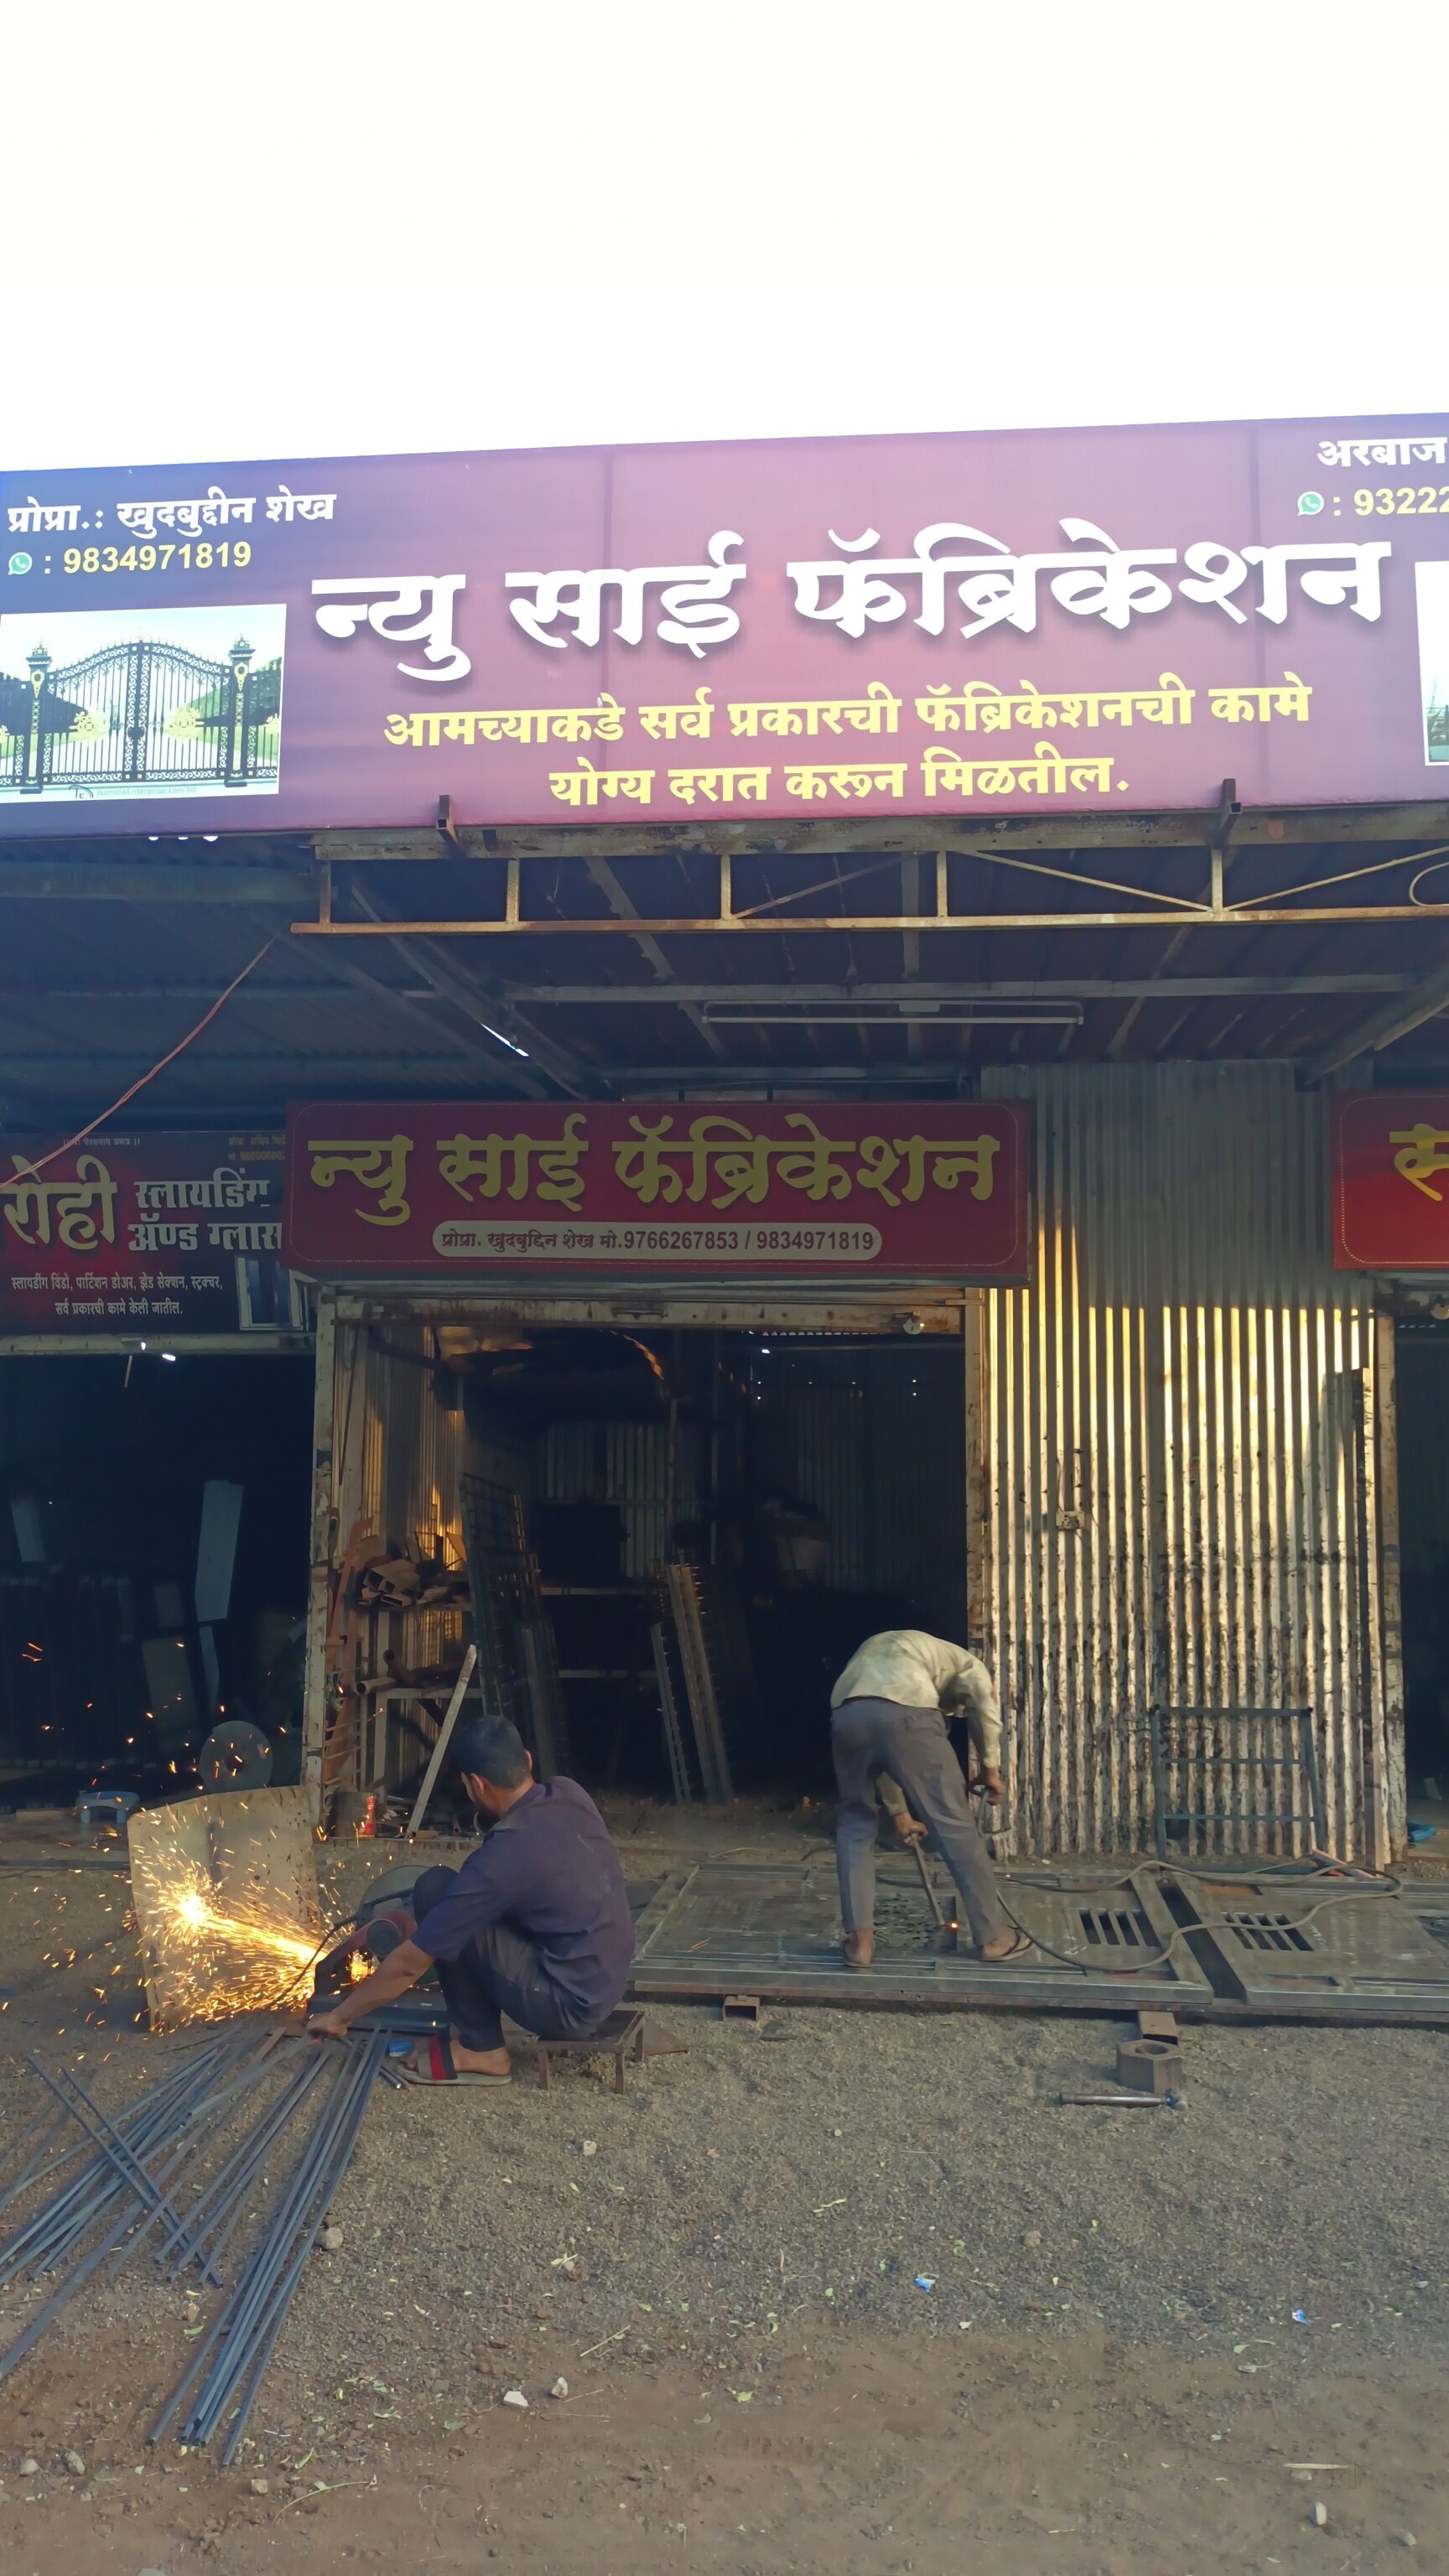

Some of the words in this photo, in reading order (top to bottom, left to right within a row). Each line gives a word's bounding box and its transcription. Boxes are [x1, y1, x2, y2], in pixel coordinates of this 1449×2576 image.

[1317, 437, 1448, 466] अरबाज
[117, 486, 256, 539] खुदबुद्दीन
[266, 485, 337, 520] शेख
[63, 541, 252, 574] 9834971819
[311, 574, 471, 681] न्यु
[505, 530, 746, 658] साई
[787, 517, 1392, 639] फॅब्रिकेशन
[384, 692, 626, 746] आमच्याकडे
[640, 687, 714, 740] सर्व
[728, 681, 901, 736] प्रकारची
[916, 672, 1195, 732] फॅब्रिकेशनची
[1208, 671, 1312, 722] कामे
[549, 757, 655, 806] योग्य
[668, 766, 771, 805] दरात
[922, 741, 1130, 797] मिळतील.
[308, 1134, 413, 1226] न्यु
[436, 1113, 589, 1213] साई
[612, 1113, 1000, 1209] फॅब्रिकेशन
[563, 1229, 594, 1249] शेख
[756, 1230, 873, 1249] 9834971819
[55, 1296, 69, 1315] सर्व
[72, 1297, 105, 1315] प्रकारची
[107, 1297, 127, 1315] कामे
[129, 1297, 149, 1315] केली
[152, 1297, 183, 1315] जातील.
